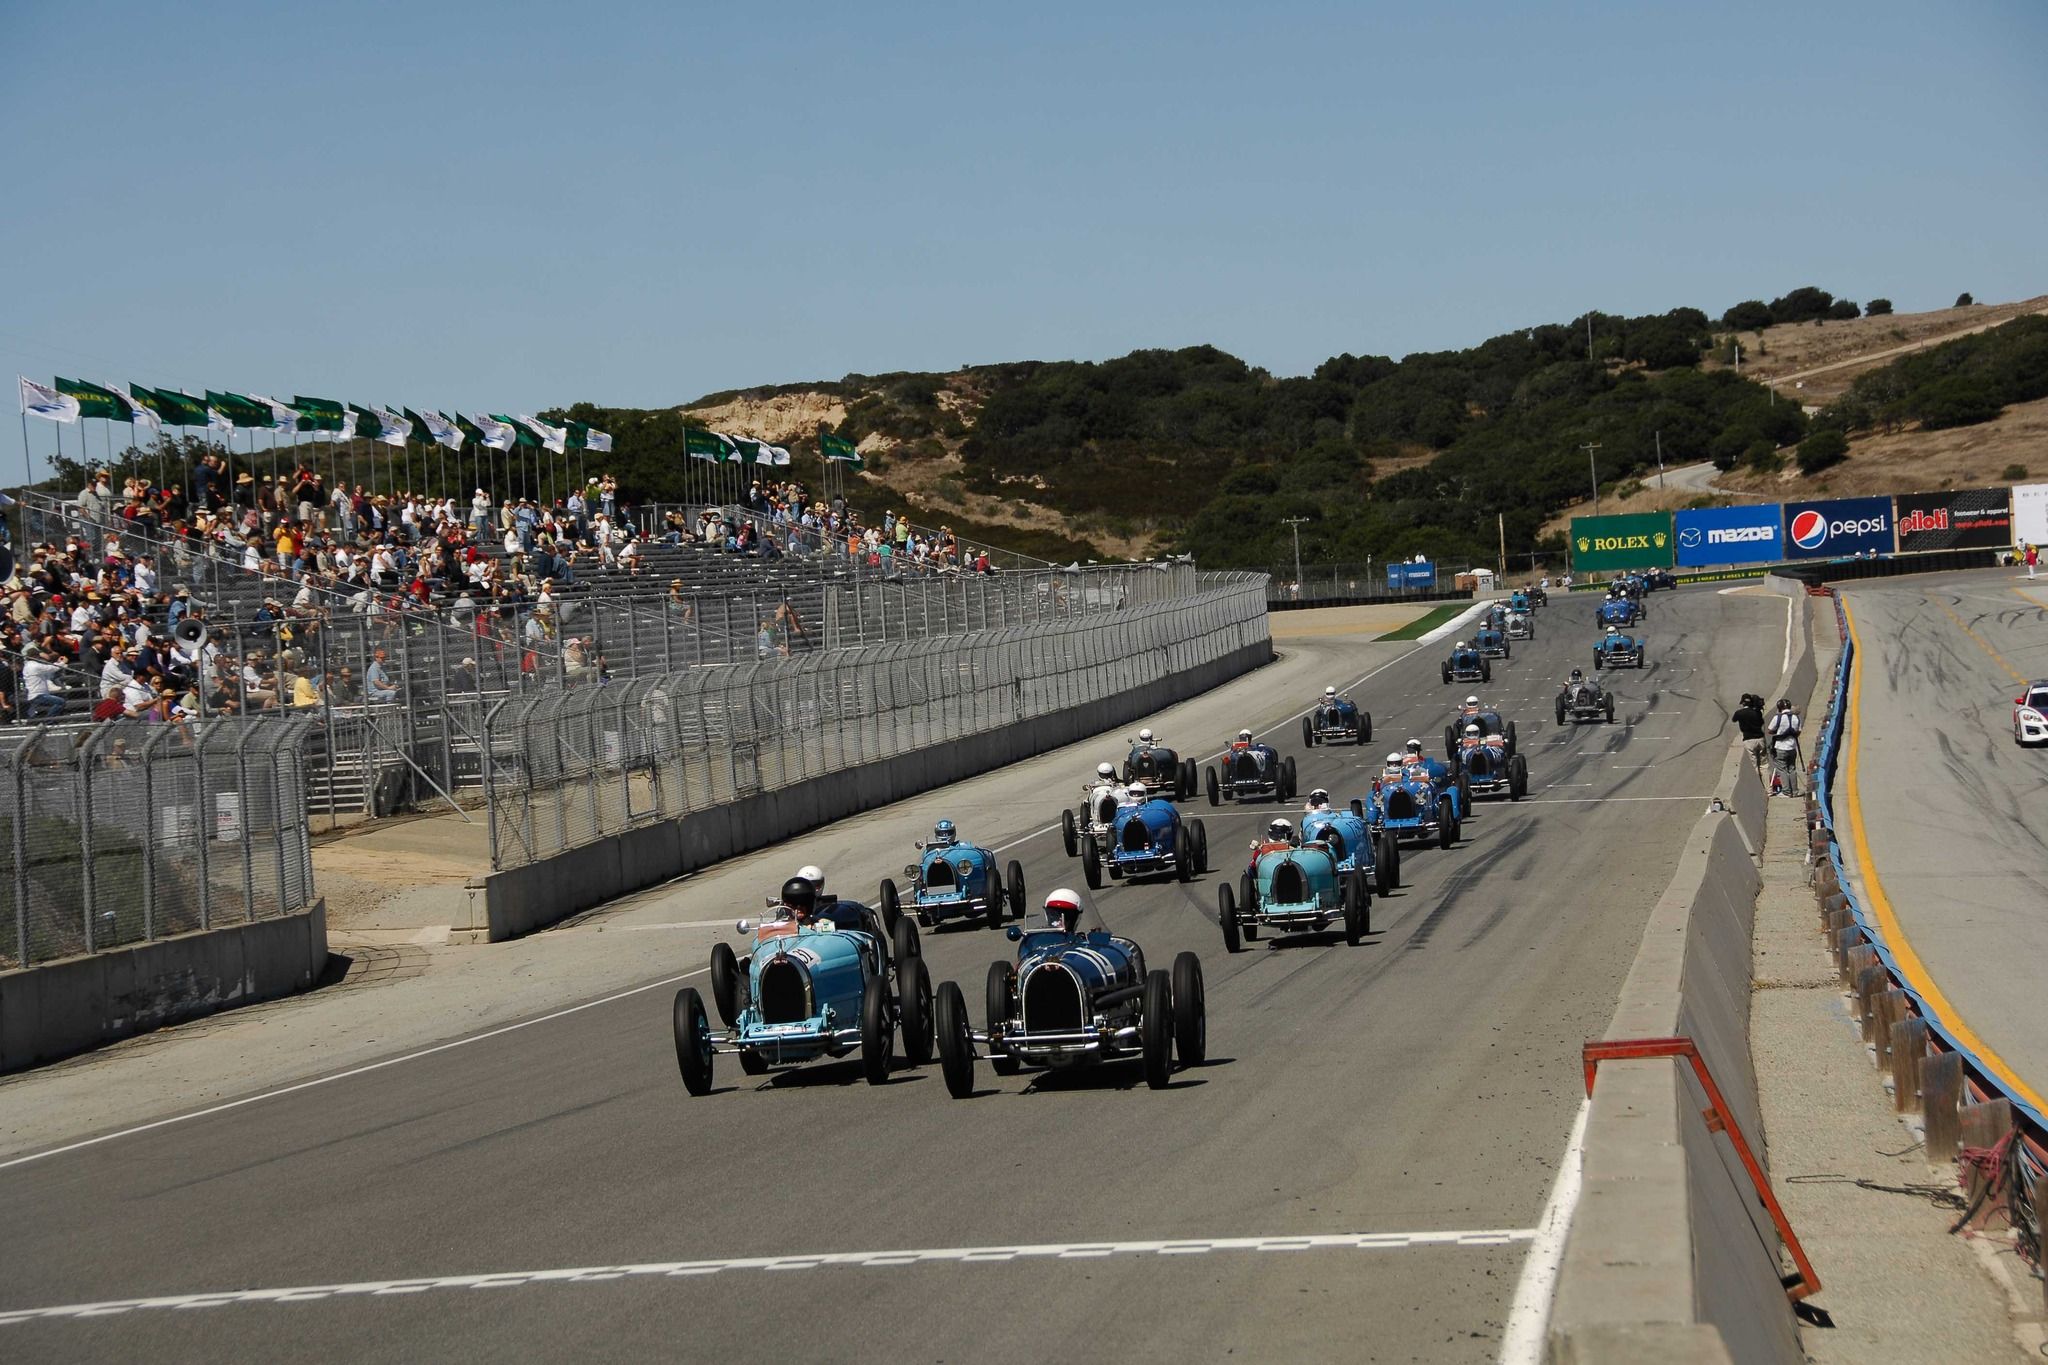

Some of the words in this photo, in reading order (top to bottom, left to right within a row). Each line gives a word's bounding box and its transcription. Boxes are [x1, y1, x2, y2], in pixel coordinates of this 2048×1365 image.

[1830, 514, 1885, 539] pepsi
[1900, 508, 1949, 536] piloti
[1595, 536, 1649, 550] ROLEX
[1708, 526, 1773, 544] mazda
